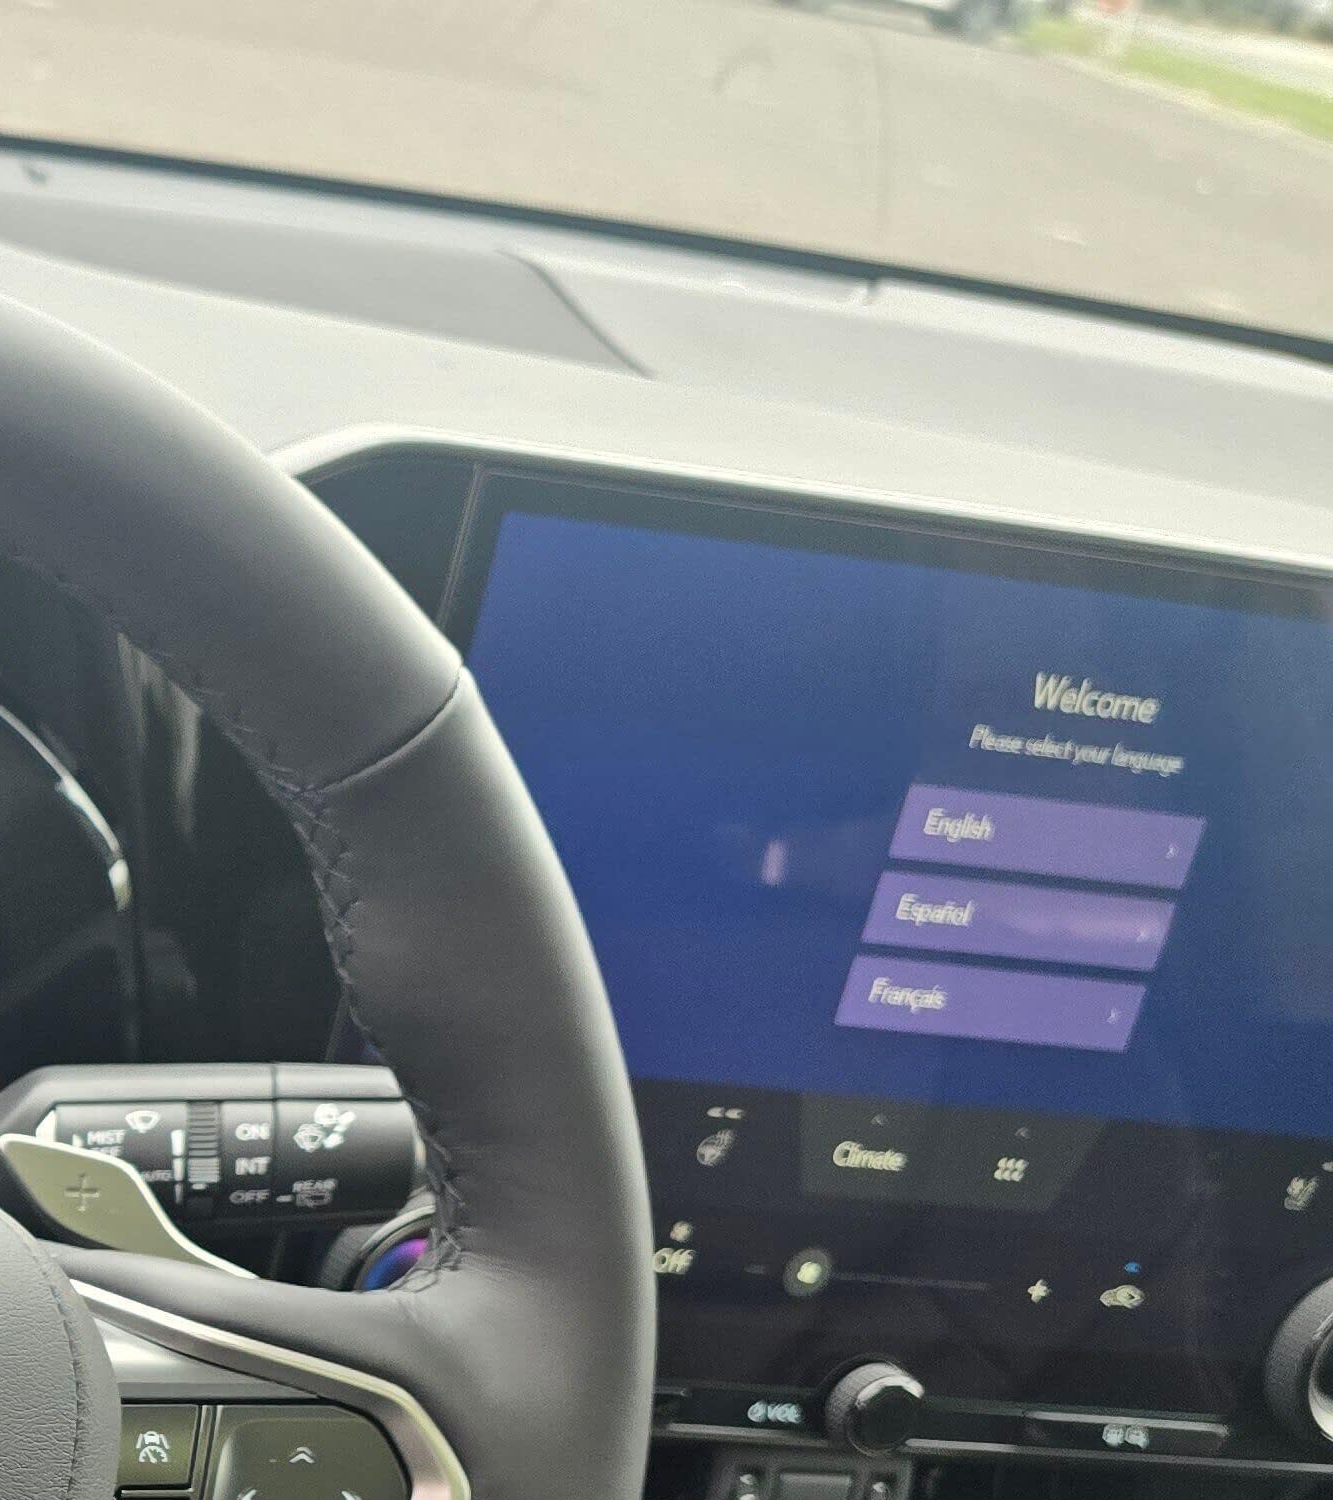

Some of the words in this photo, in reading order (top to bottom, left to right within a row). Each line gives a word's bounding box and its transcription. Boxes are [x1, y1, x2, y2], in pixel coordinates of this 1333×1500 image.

[1034, 671, 1161, 724] Welcome
[969, 723, 1026, 754] Please
[1025, 733, 1074, 760] select
[1071, 744, 1112, 766] your
[1110, 741, 1184, 777] language
[923, 808, 995, 842] English
[895, 894, 976, 928] Español
[868, 976, 949, 1014] Français
[86, 1129, 126, 1145] MIST
[235, 1122, 271, 1141] ON
[234, 1155, 271, 1176] INT
[833, 1141, 908, 1171] Climate
[229, 1188, 271, 1205] OFF
[292, 1178, 337, 1194] REAR
